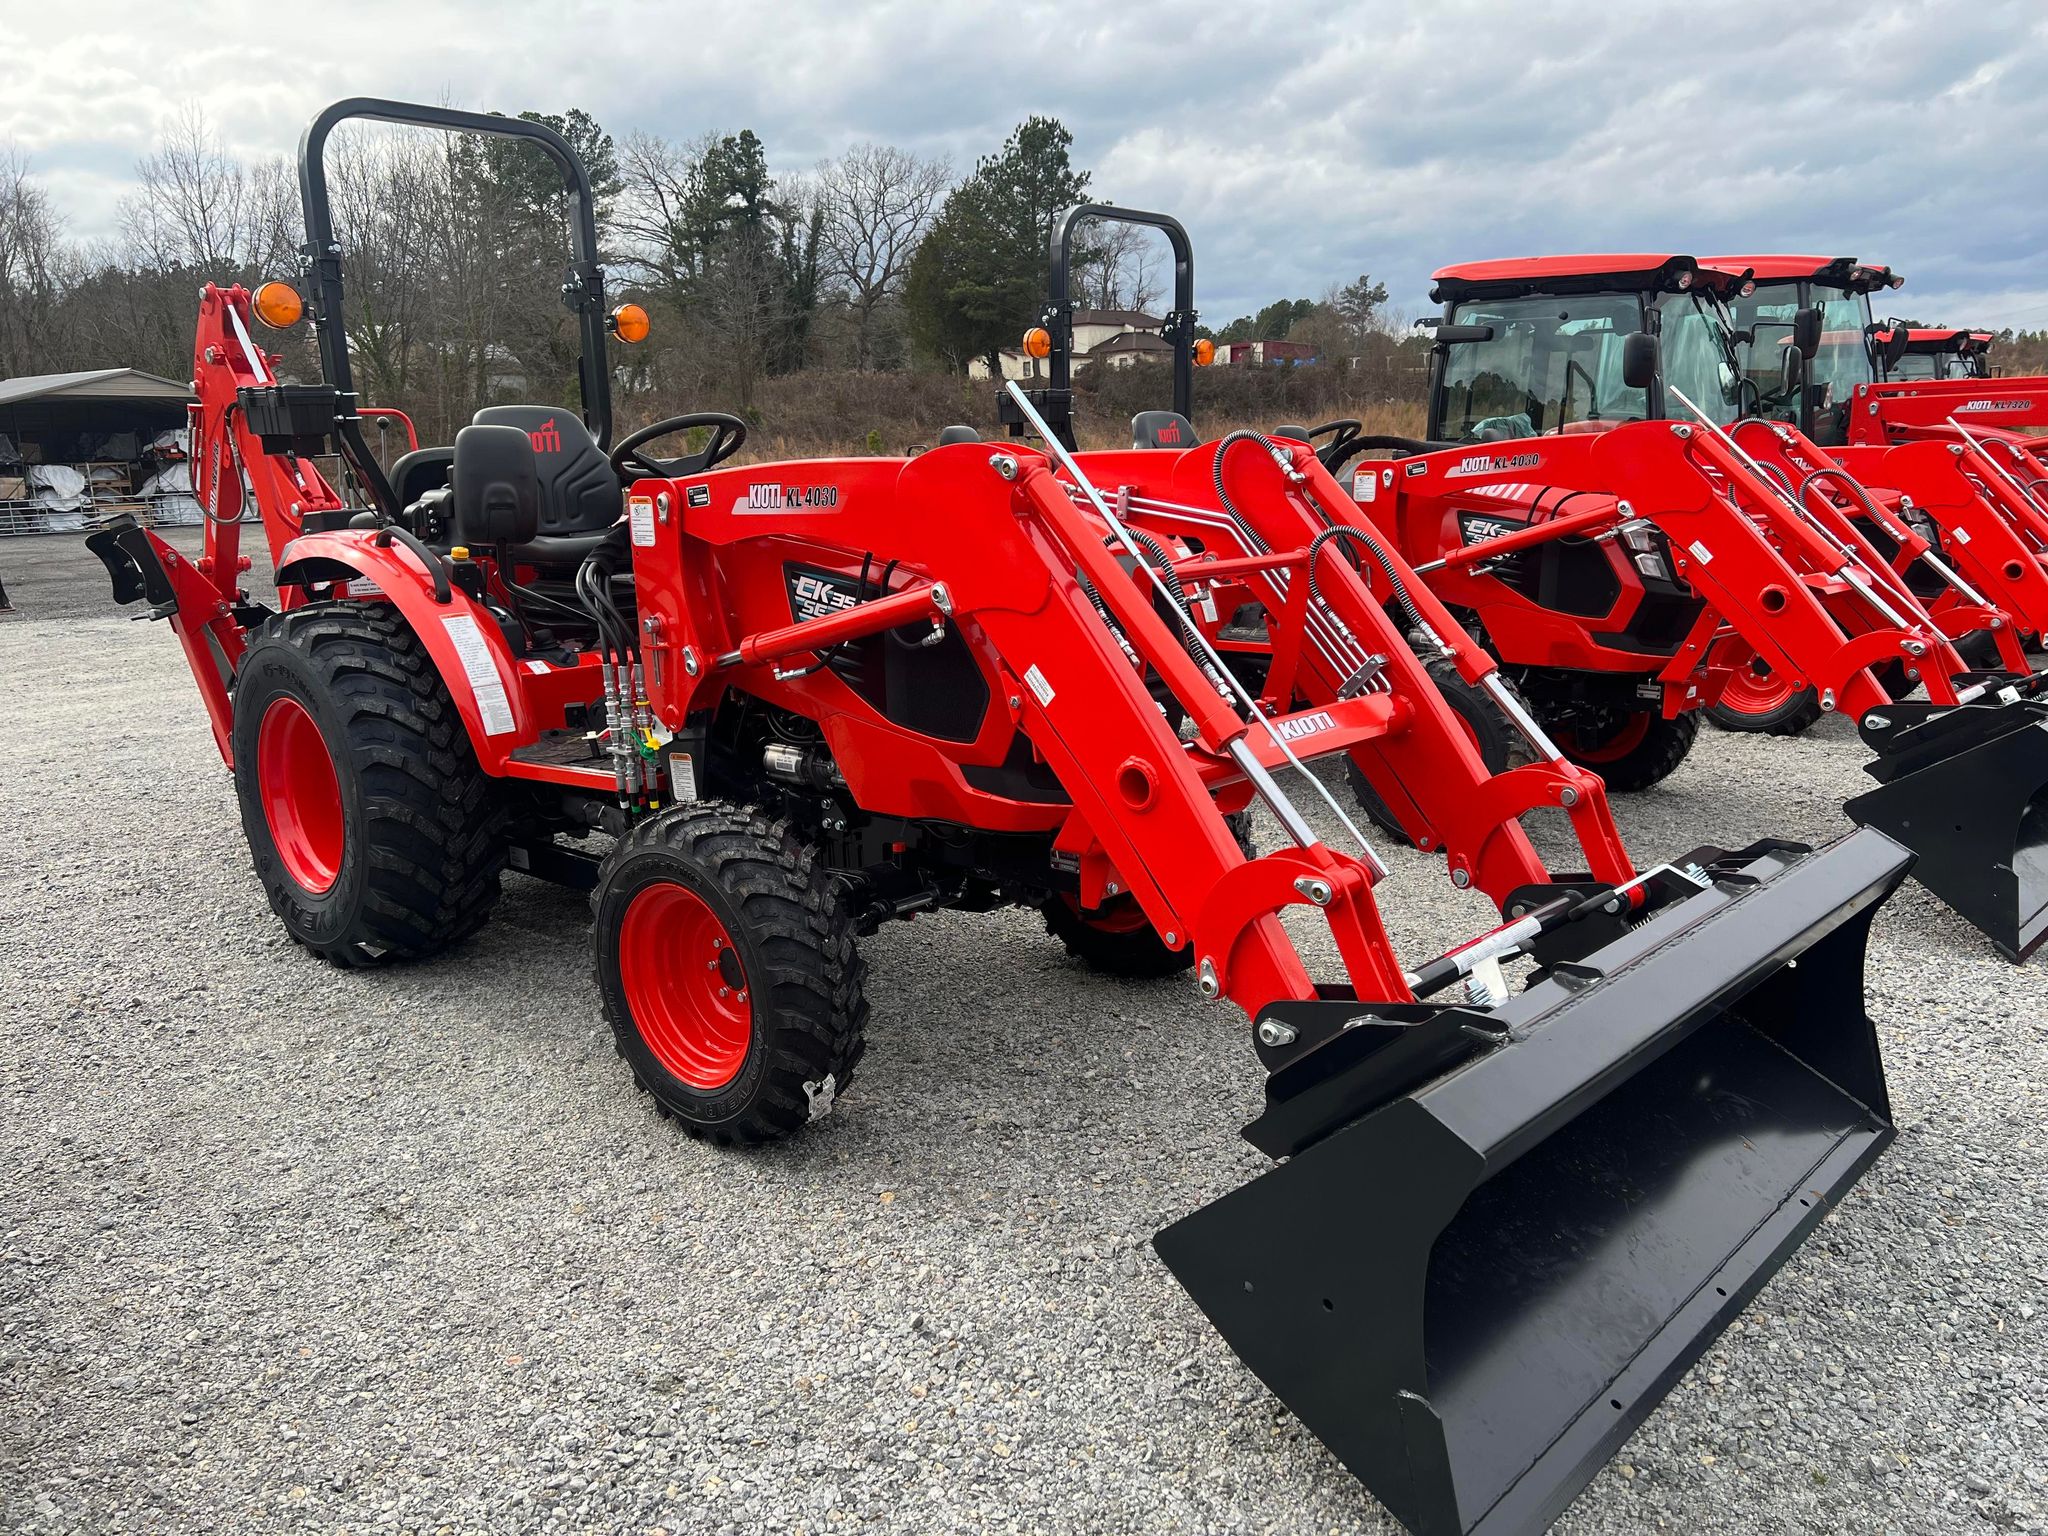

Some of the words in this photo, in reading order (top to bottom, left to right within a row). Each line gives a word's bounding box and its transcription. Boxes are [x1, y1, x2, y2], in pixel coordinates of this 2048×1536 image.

[1966, 400, 1992, 410] KIOTI
[528, 431, 560, 453] OTI
[1157, 428, 1181, 443] KIOTI
[1460, 456, 1491, 474] KIOTI
[748, 483, 782, 509] KIOTI
[801, 599, 828, 617] SE
[1277, 711, 1336, 740] KIOTI
